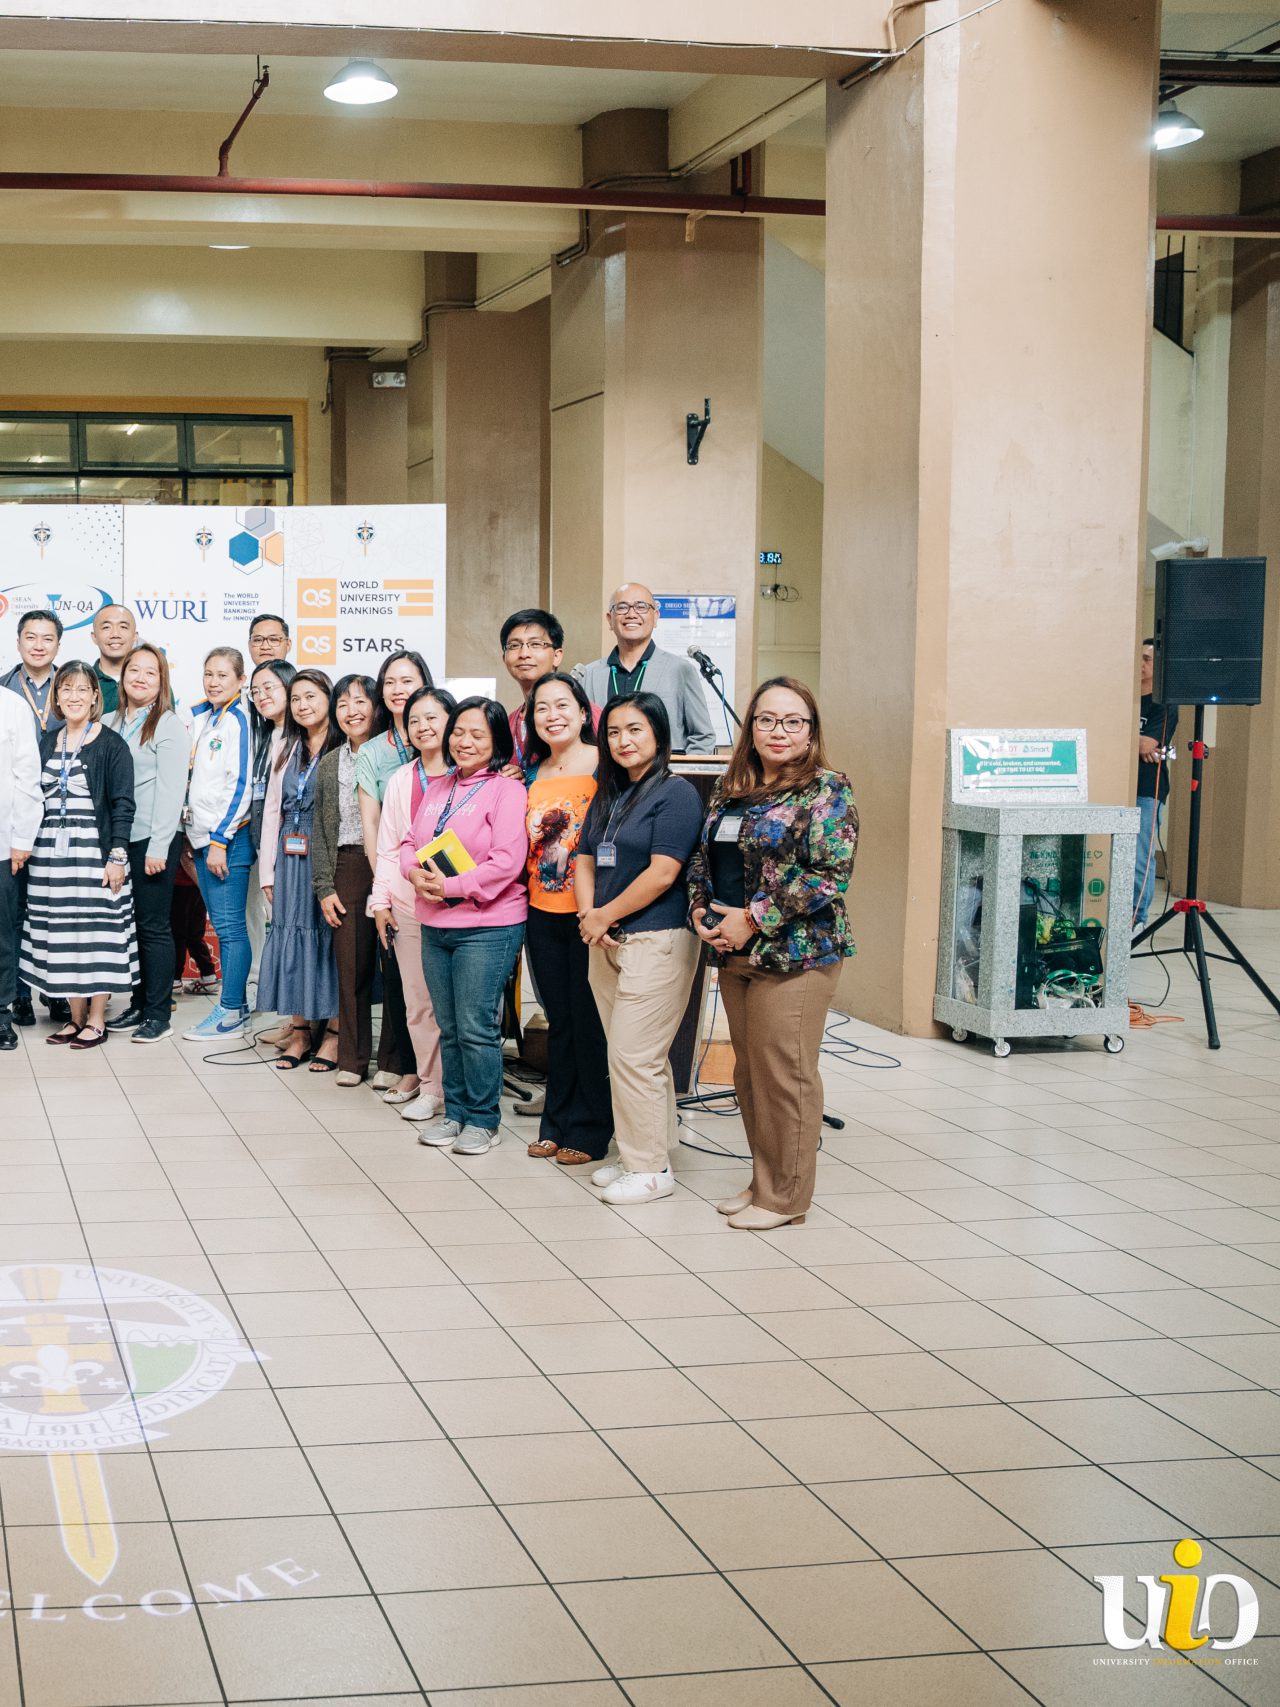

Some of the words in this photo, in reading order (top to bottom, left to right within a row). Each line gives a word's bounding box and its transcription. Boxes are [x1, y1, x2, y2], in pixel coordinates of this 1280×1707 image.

[340, 580, 379, 589] WORLD
[302, 588, 332, 608] QS
[340, 593, 401, 602] UNIVERSITY
[134, 599, 208, 623] WURI
[340, 606, 393, 615] RANKINGS
[302, 635, 332, 656] QS
[343, 638, 405, 653] STARS
[74, 1268, 219, 1332] UNIVERSITY
[35, 1421, 98, 1437] 1911
[93, 1431, 145, 1447] CITY
